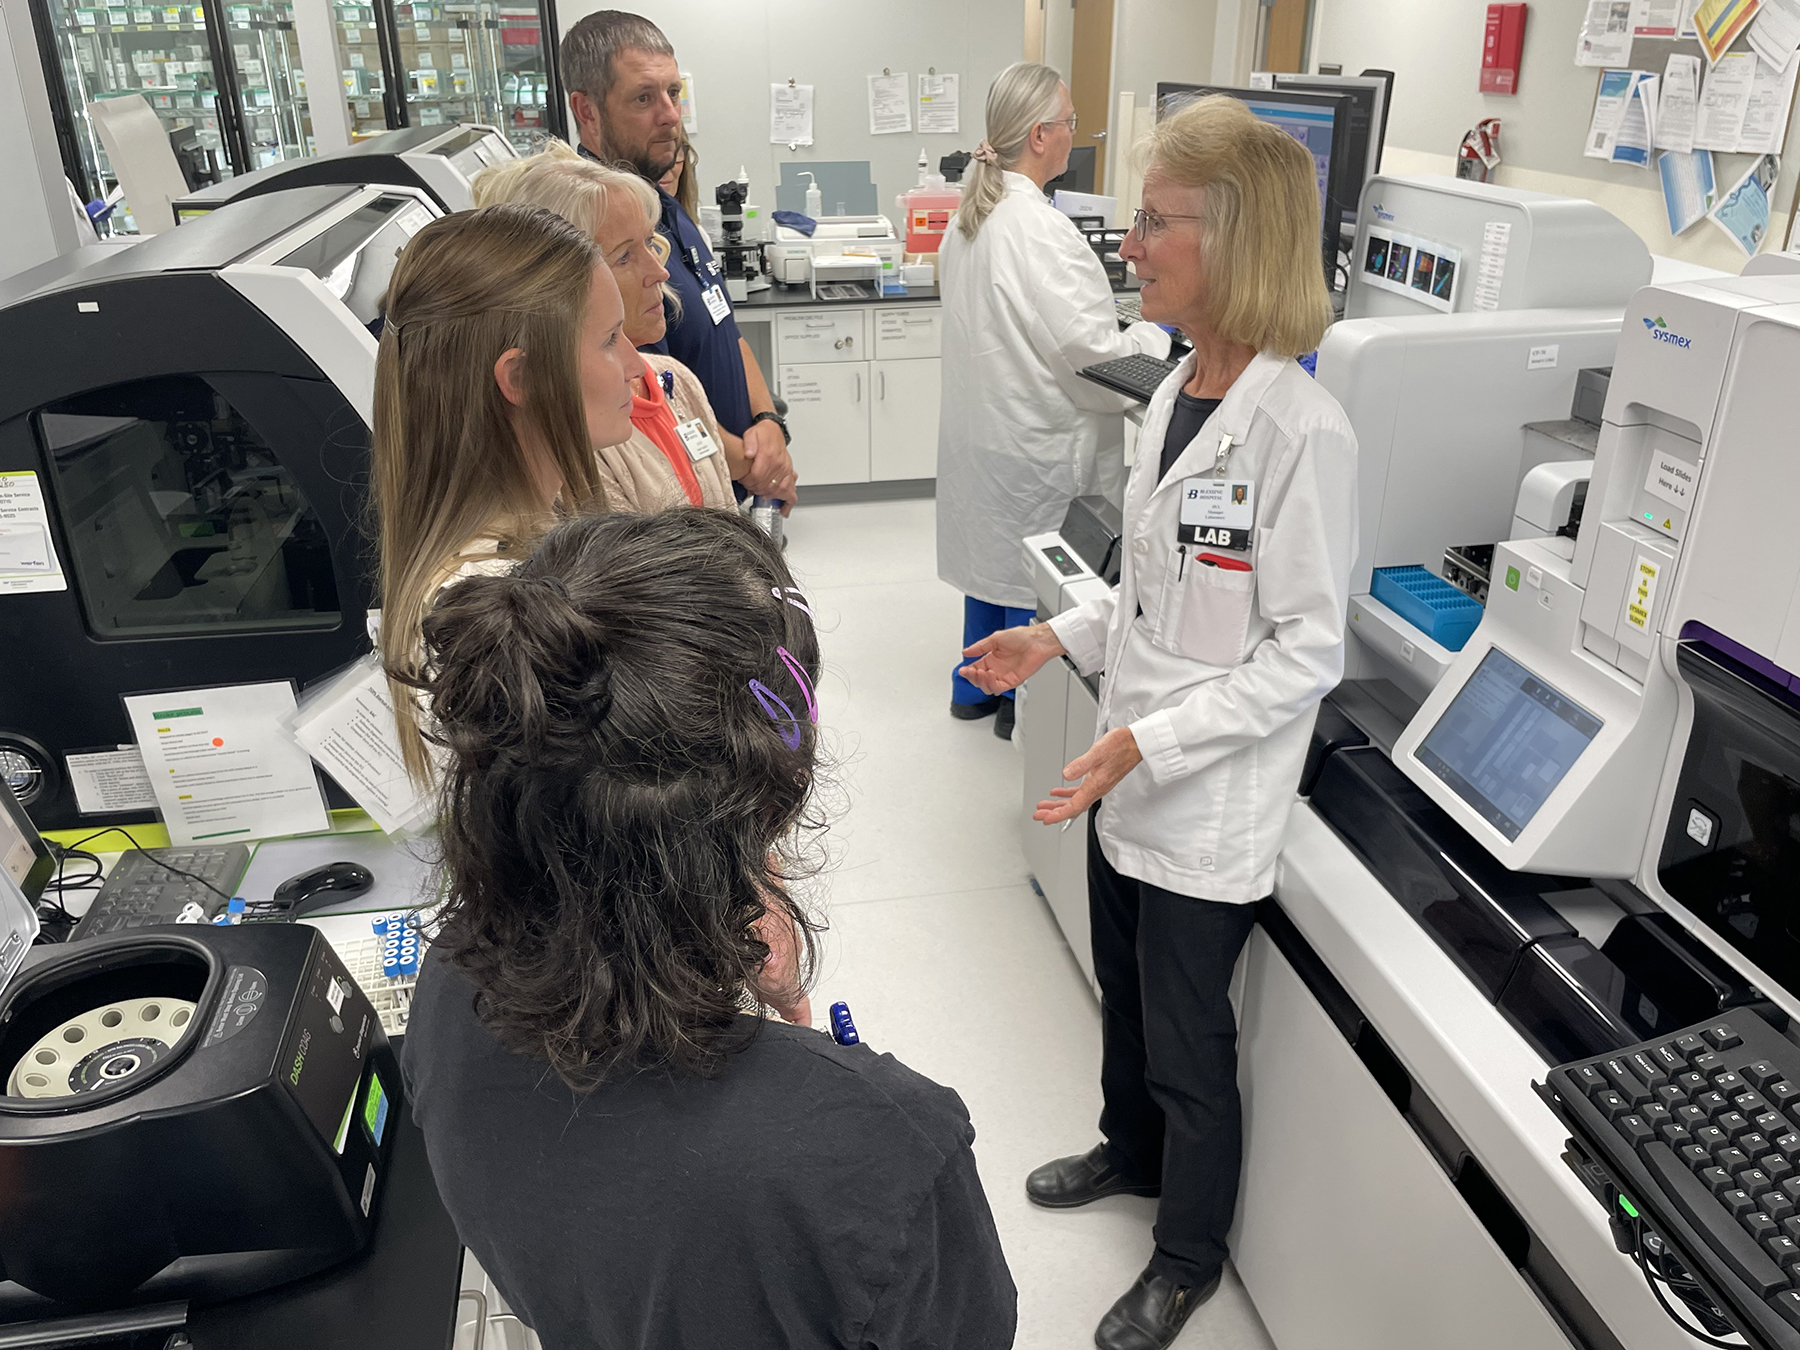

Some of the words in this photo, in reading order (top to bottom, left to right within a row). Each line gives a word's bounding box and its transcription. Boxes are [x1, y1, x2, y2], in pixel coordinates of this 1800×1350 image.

[1653, 328, 1692, 349] sysmex
[1660, 461, 1675, 474] Load
[1675, 468, 1691, 483] Slides
[1658, 477, 1672, 490] Here
[1194, 526, 1231, 546] LAB
[1638, 587, 1648, 598] THIS
[290, 1050, 305, 1086] DASH
[299, 1028, 312, 1055] COAG
